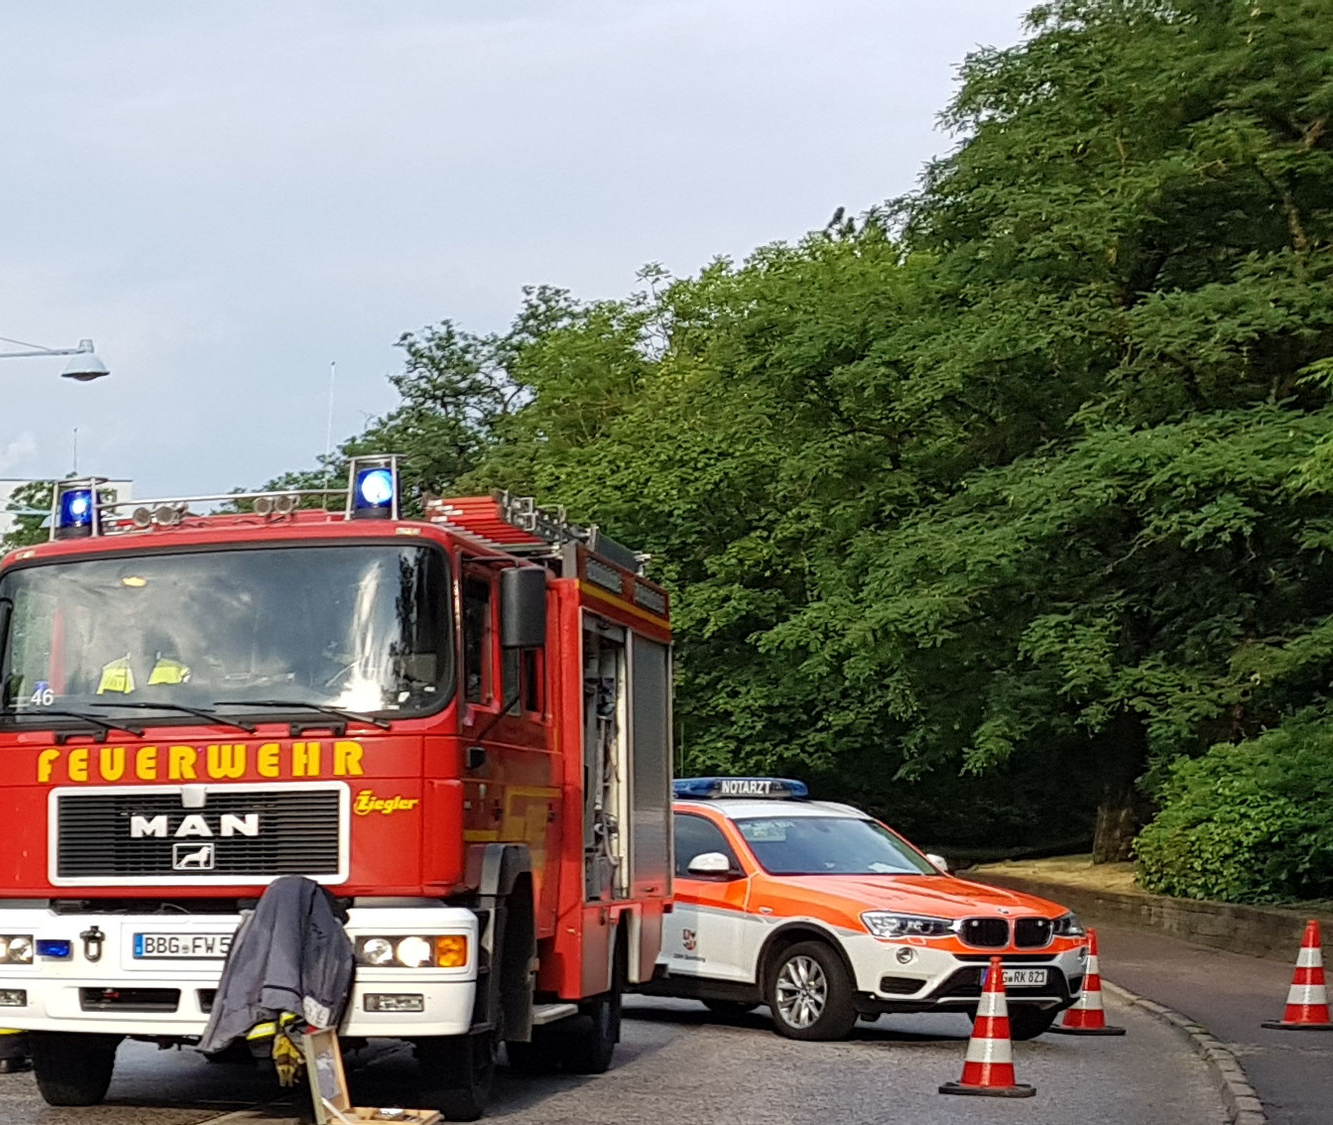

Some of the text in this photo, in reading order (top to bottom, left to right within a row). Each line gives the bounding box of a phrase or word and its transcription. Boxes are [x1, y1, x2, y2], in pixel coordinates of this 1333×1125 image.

[30, 688, 54, 706] 46
[37, 741, 364, 782] FEUERWEHR
[721, 780, 772, 794] NOTARZT
[353, 790, 420, 816] Ziegler
[130, 813, 259, 838] MAN
[144, 937, 180, 954] BBG
[192, 937, 215, 954] FW
